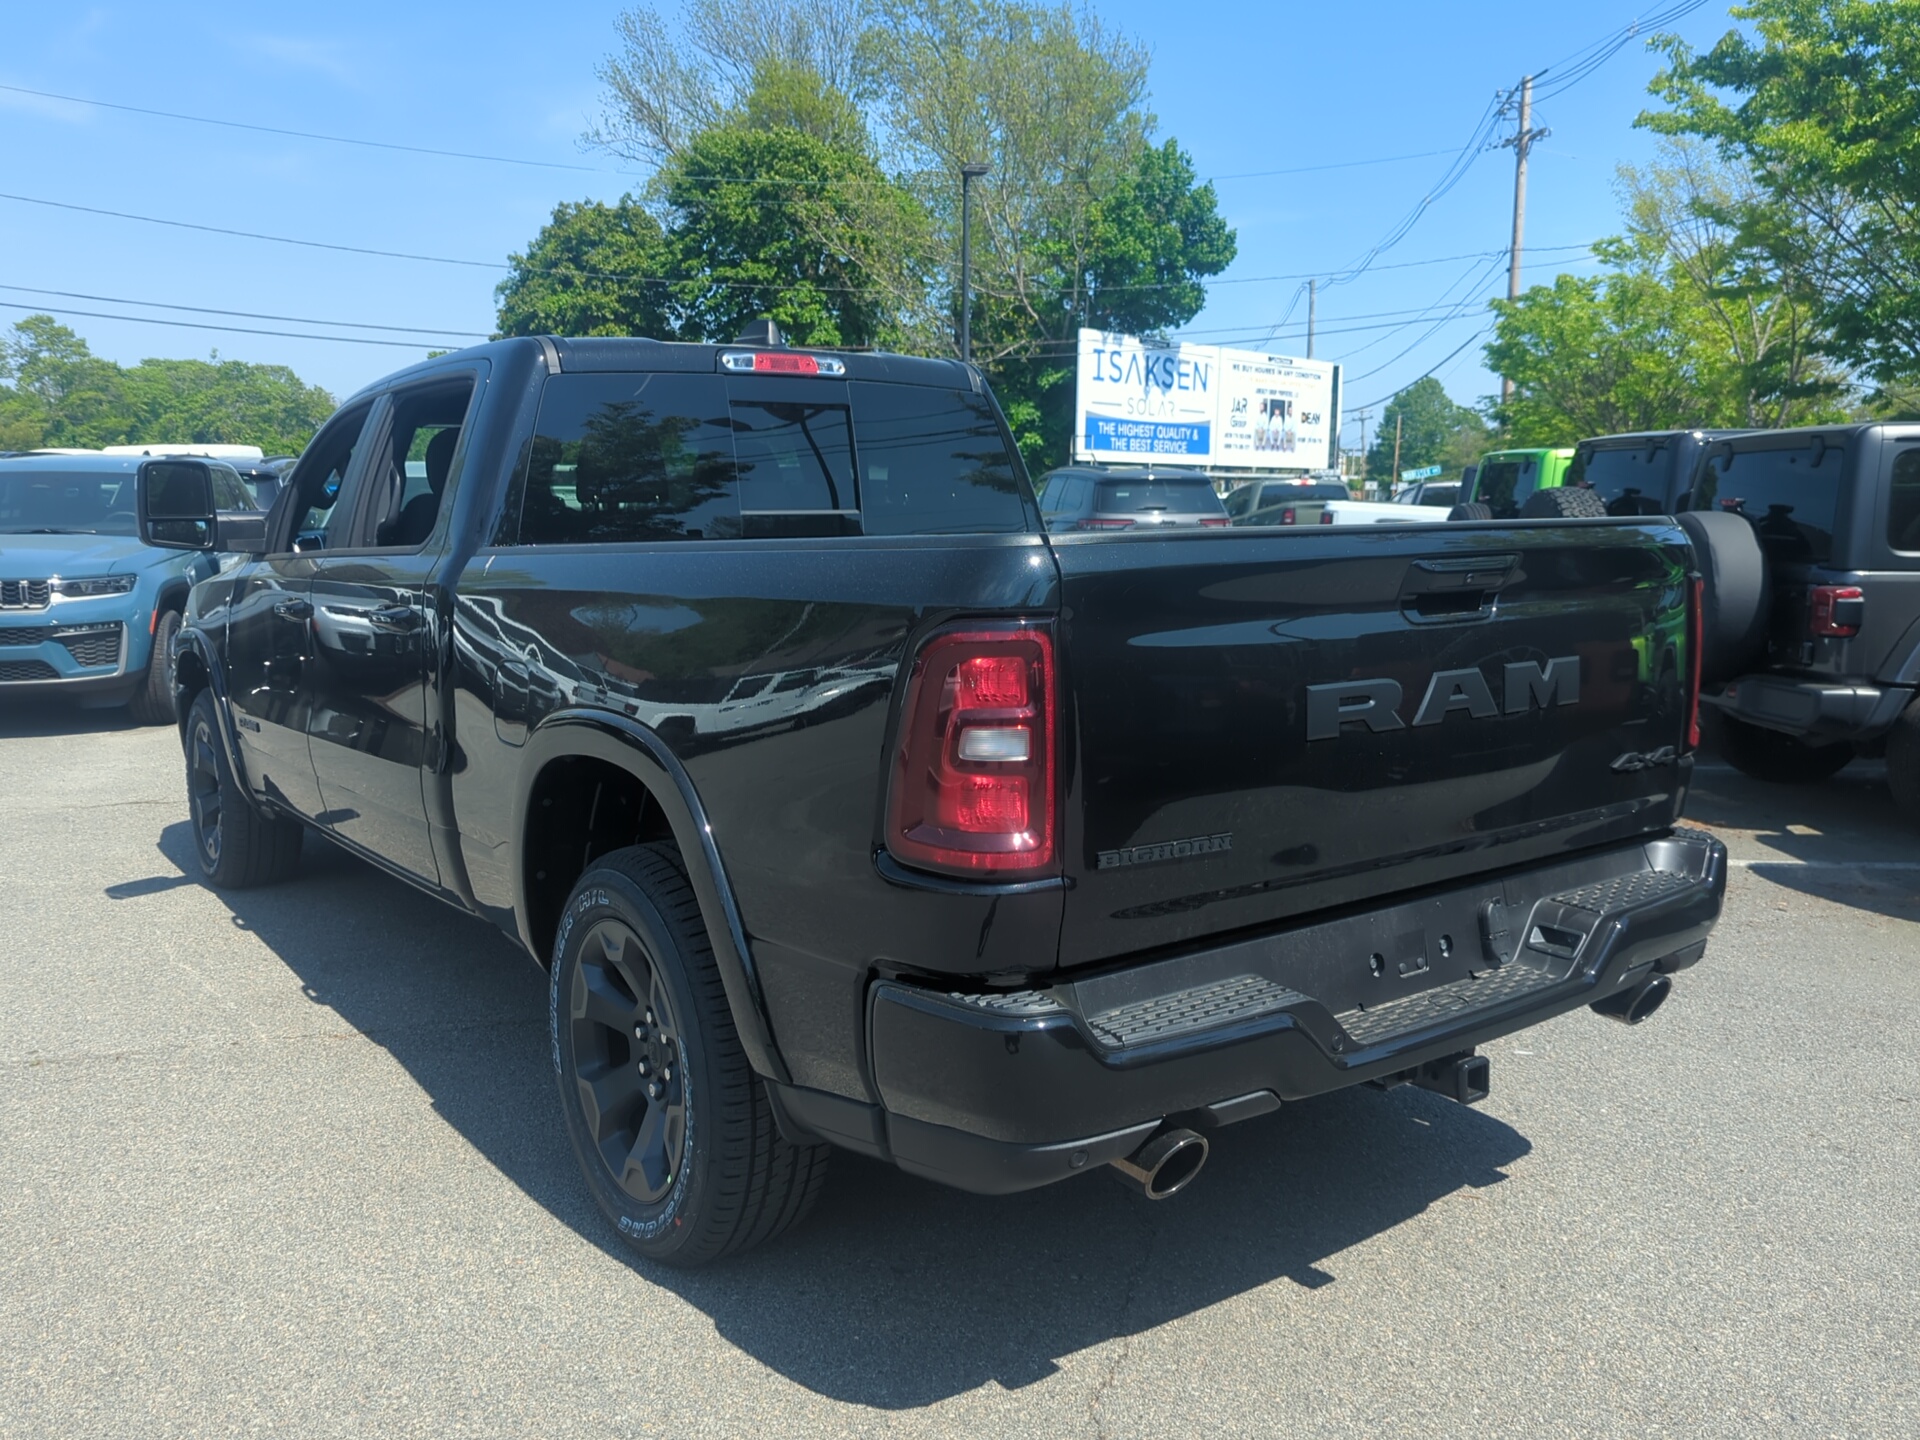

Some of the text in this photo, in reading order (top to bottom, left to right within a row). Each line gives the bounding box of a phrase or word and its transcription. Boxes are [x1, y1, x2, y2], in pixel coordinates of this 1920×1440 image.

[1092, 348, 1209, 393] ISAKSEN
[1127, 397, 1175, 417] SOLAR
[1231, 397, 1248, 414] JAR
[1098, 421, 1199, 441] THE HIGHEST QUALITY &
[1110, 436, 1188, 454] THE BEST SERVICE
[1306, 655, 1581, 742] RAM
